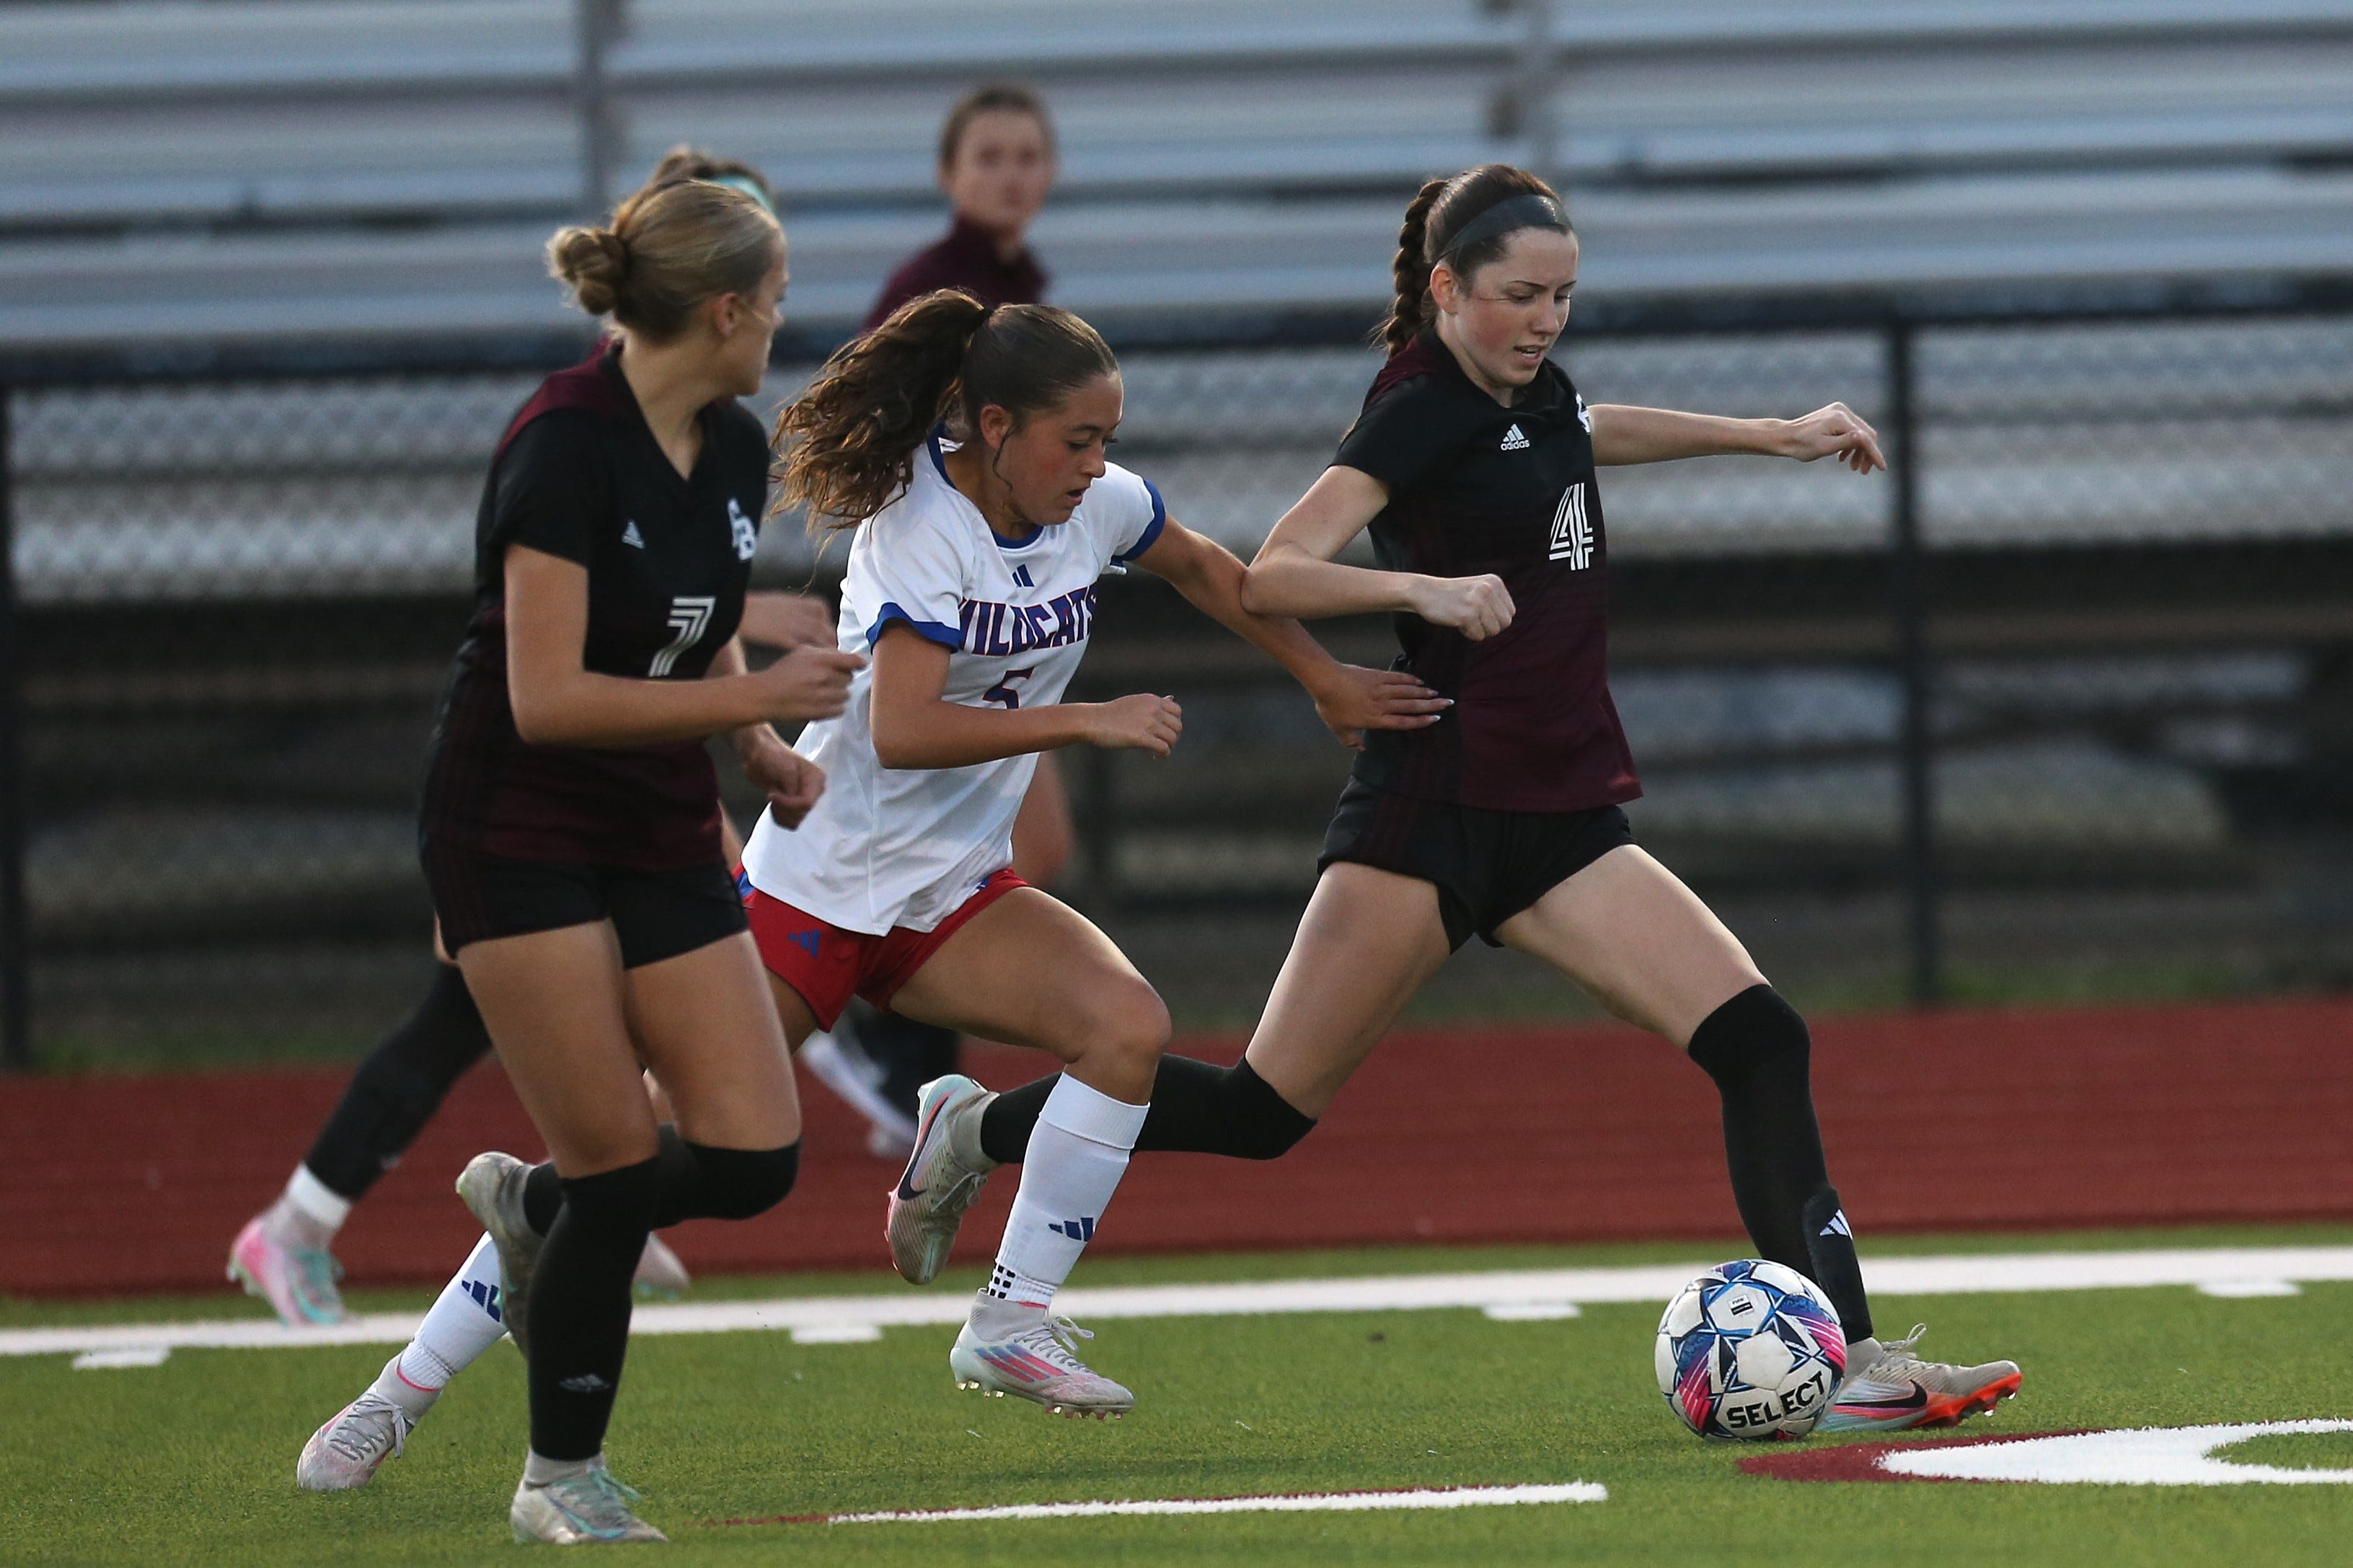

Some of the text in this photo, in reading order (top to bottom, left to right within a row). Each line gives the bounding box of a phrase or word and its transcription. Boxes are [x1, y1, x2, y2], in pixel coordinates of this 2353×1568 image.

[1500, 439, 1530, 451] adidas
[1548, 482, 1594, 571] 4
[648, 595, 717, 678] 7
[1726, 1370, 1826, 1429] SELECT
